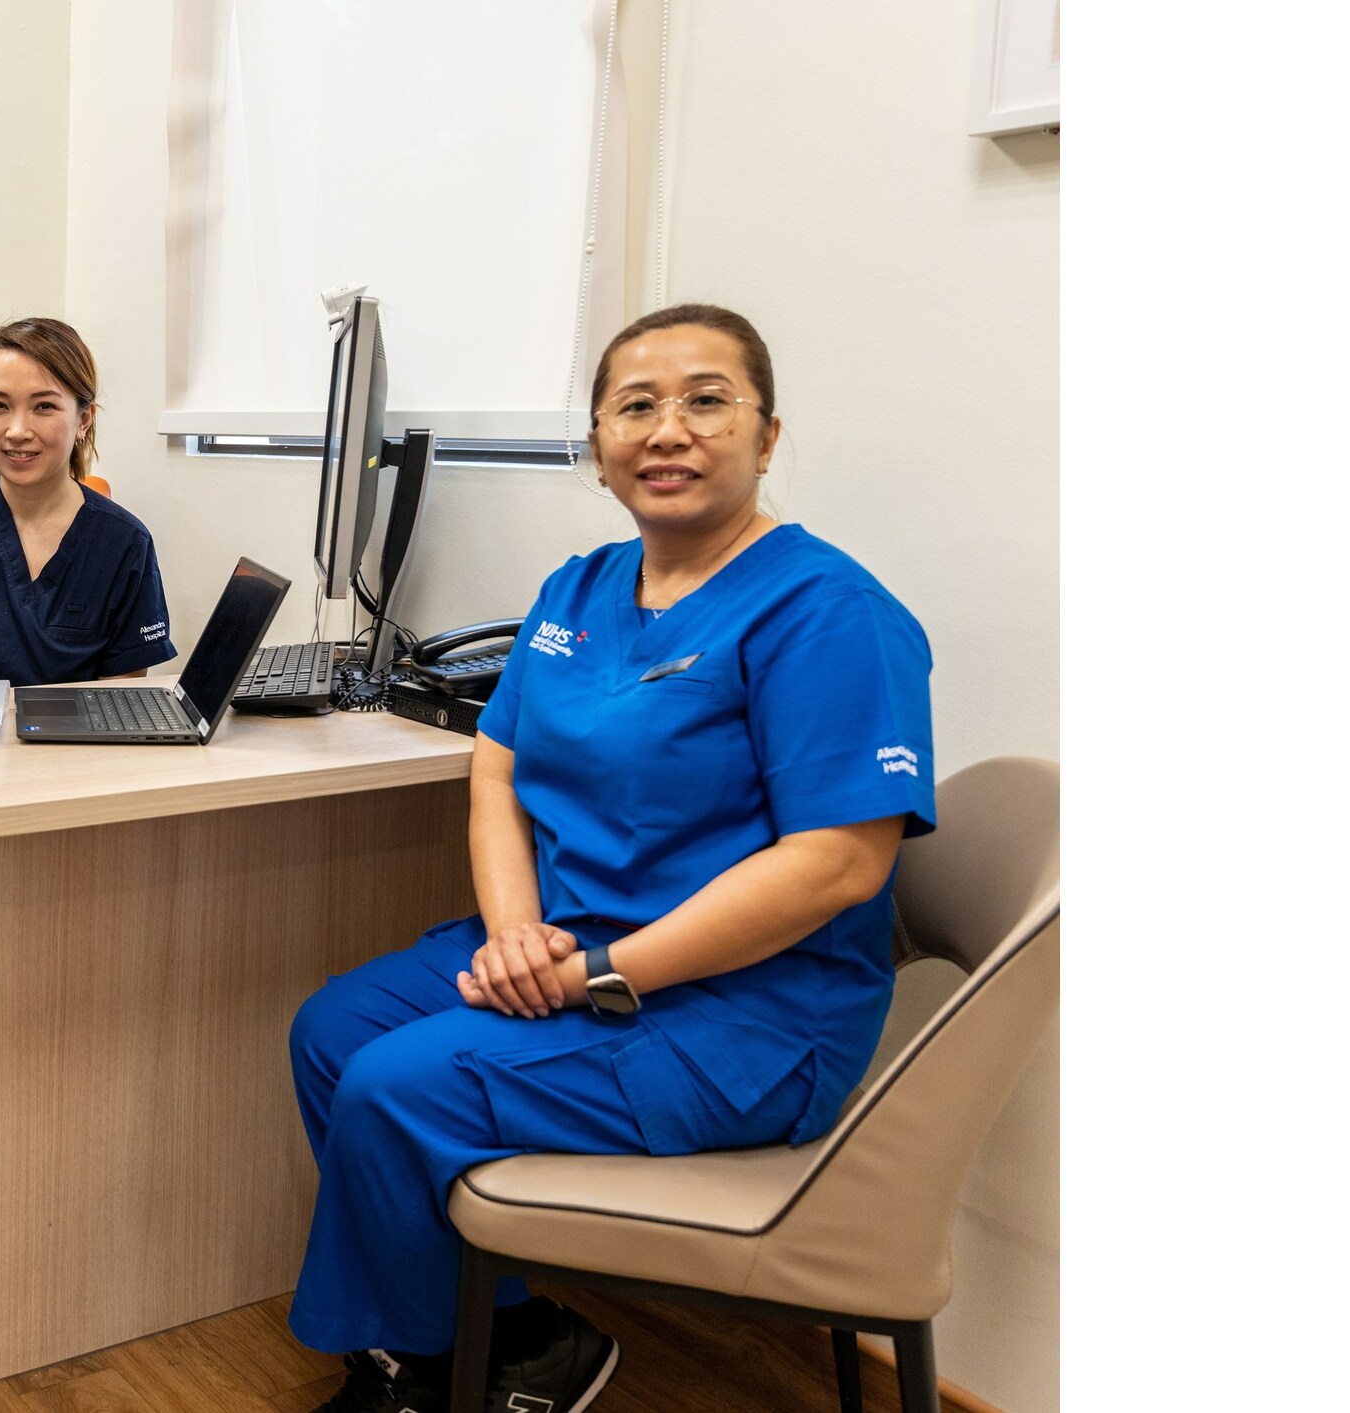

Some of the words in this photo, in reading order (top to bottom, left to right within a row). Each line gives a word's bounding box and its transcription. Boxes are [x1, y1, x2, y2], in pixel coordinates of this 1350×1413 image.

[140, 621, 166, 634] Alexandra
[536, 620, 574, 645] NUHS
[144, 628, 166, 641] Hospital
